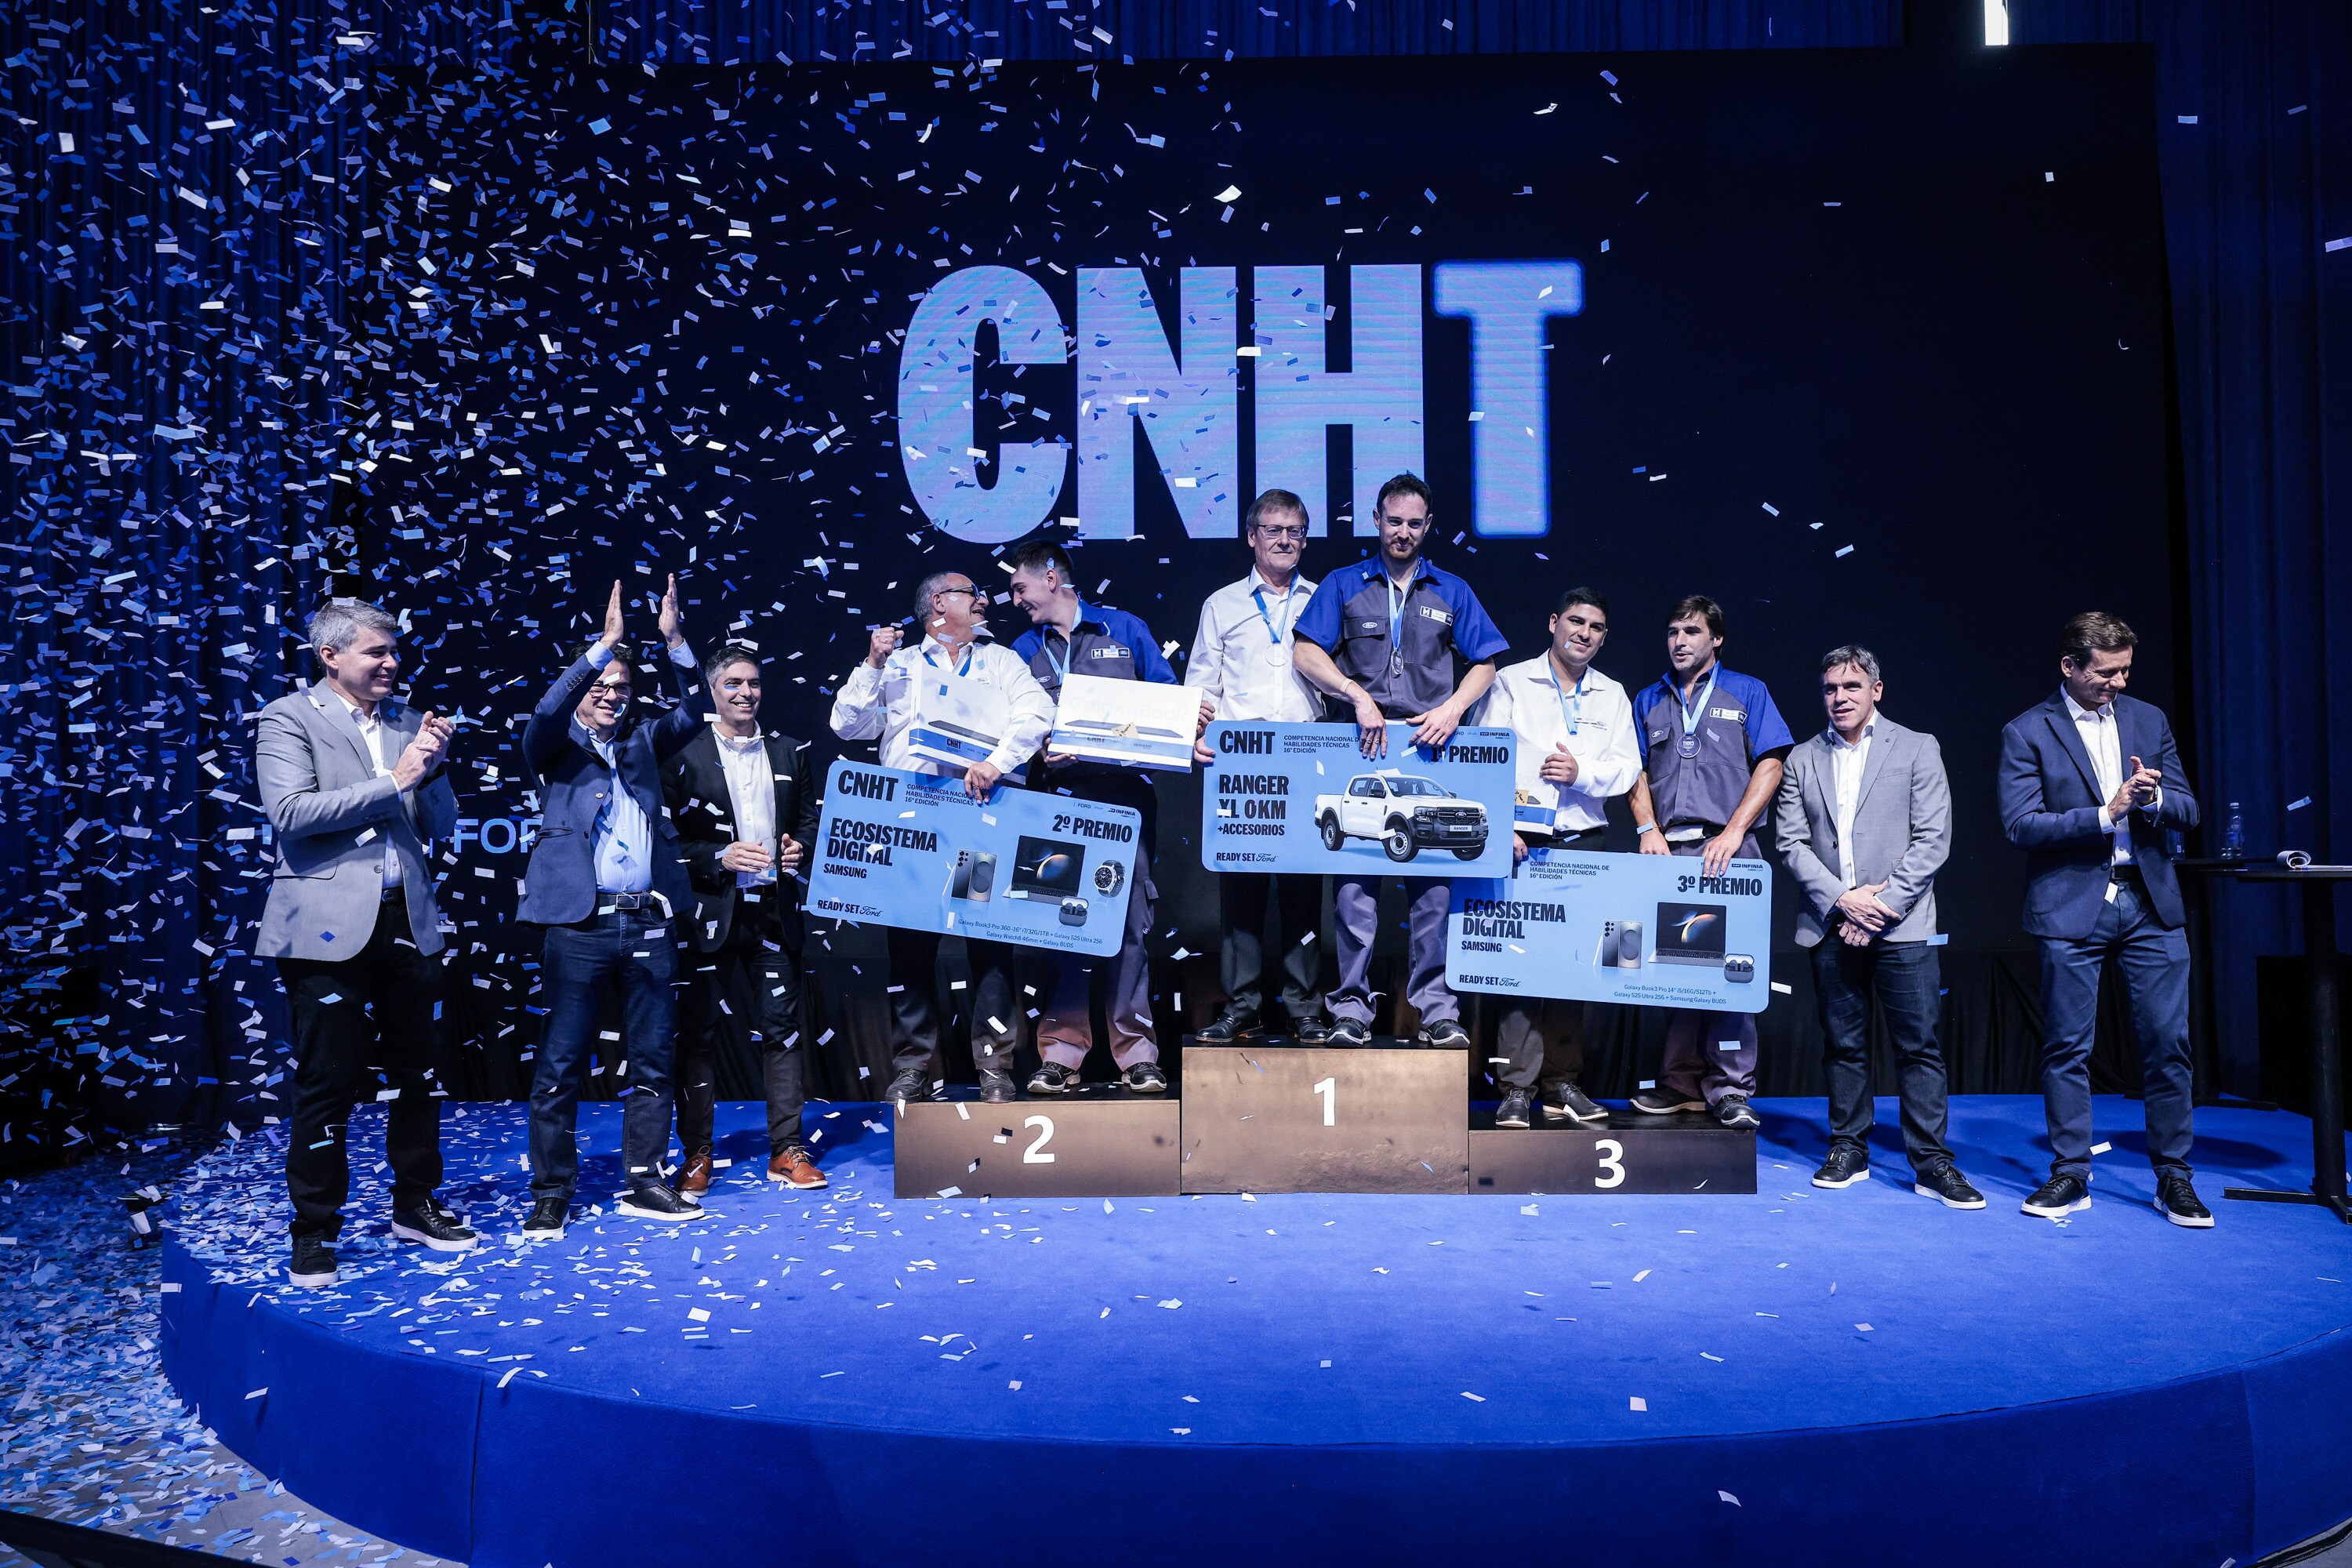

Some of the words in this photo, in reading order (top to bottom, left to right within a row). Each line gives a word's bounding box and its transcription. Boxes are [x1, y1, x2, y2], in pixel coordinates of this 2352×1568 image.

[897, 259, 1584, 543] CNHT
[946, 738, 962, 750] CNHT
[1219, 730, 1276, 754] CNHT
[1449, 746, 1509, 764] PREMIO
[838, 770, 899, 801] CNHT
[907, 783, 949, 795] COMPETENCIA
[1218, 774, 1290, 795] RANGER
[906, 790, 945, 801] HABILIDADES
[946, 796, 975, 806] TÉCNICAS
[914, 798, 939, 807] EDICIÓN
[1218, 798, 1240, 818] XL
[829, 818, 937, 852] ECOSISTEMA
[1052, 814, 1071, 833] 2º
[1072, 817, 1133, 843] PREMIO
[1218, 823, 1285, 836] +ACCESORIOS
[826, 837, 893, 866] DIGITAL
[1216, 852, 1240, 861] READY
[1242, 852, 1256, 862] SET
[1256, 853, 1276, 862] Ford
[823, 863, 868, 879] SAMSUNG
[1678, 875, 1696, 893] 3º
[1698, 876, 1762, 896] PREMIO
[818, 899, 844, 911] READY
[844, 903, 860, 913] SET
[860, 906, 882, 916] Ford
[1464, 898, 1566, 923] ECOSISTEMA
[958, 919, 975, 927] Galaxy
[1022, 927, 1050, 937] i7/32G/1TB
[1054, 932, 1070, 941] Galaxy
[1462, 917, 1526, 939] DIGITAL
[986, 931, 1003, 939] Galaxy
[1043, 938, 1059, 947] Galaxy
[1461, 940, 1502, 953] SAMSUNG
[1459, 975, 1484, 985] READY
[1485, 976, 1499, 985] SET
[1499, 977, 1519, 987] Ford
[1312, 1077, 1336, 1127] 1
[1022, 1115, 1055, 1164] 2
[1593, 1139, 1627, 1189] 3
